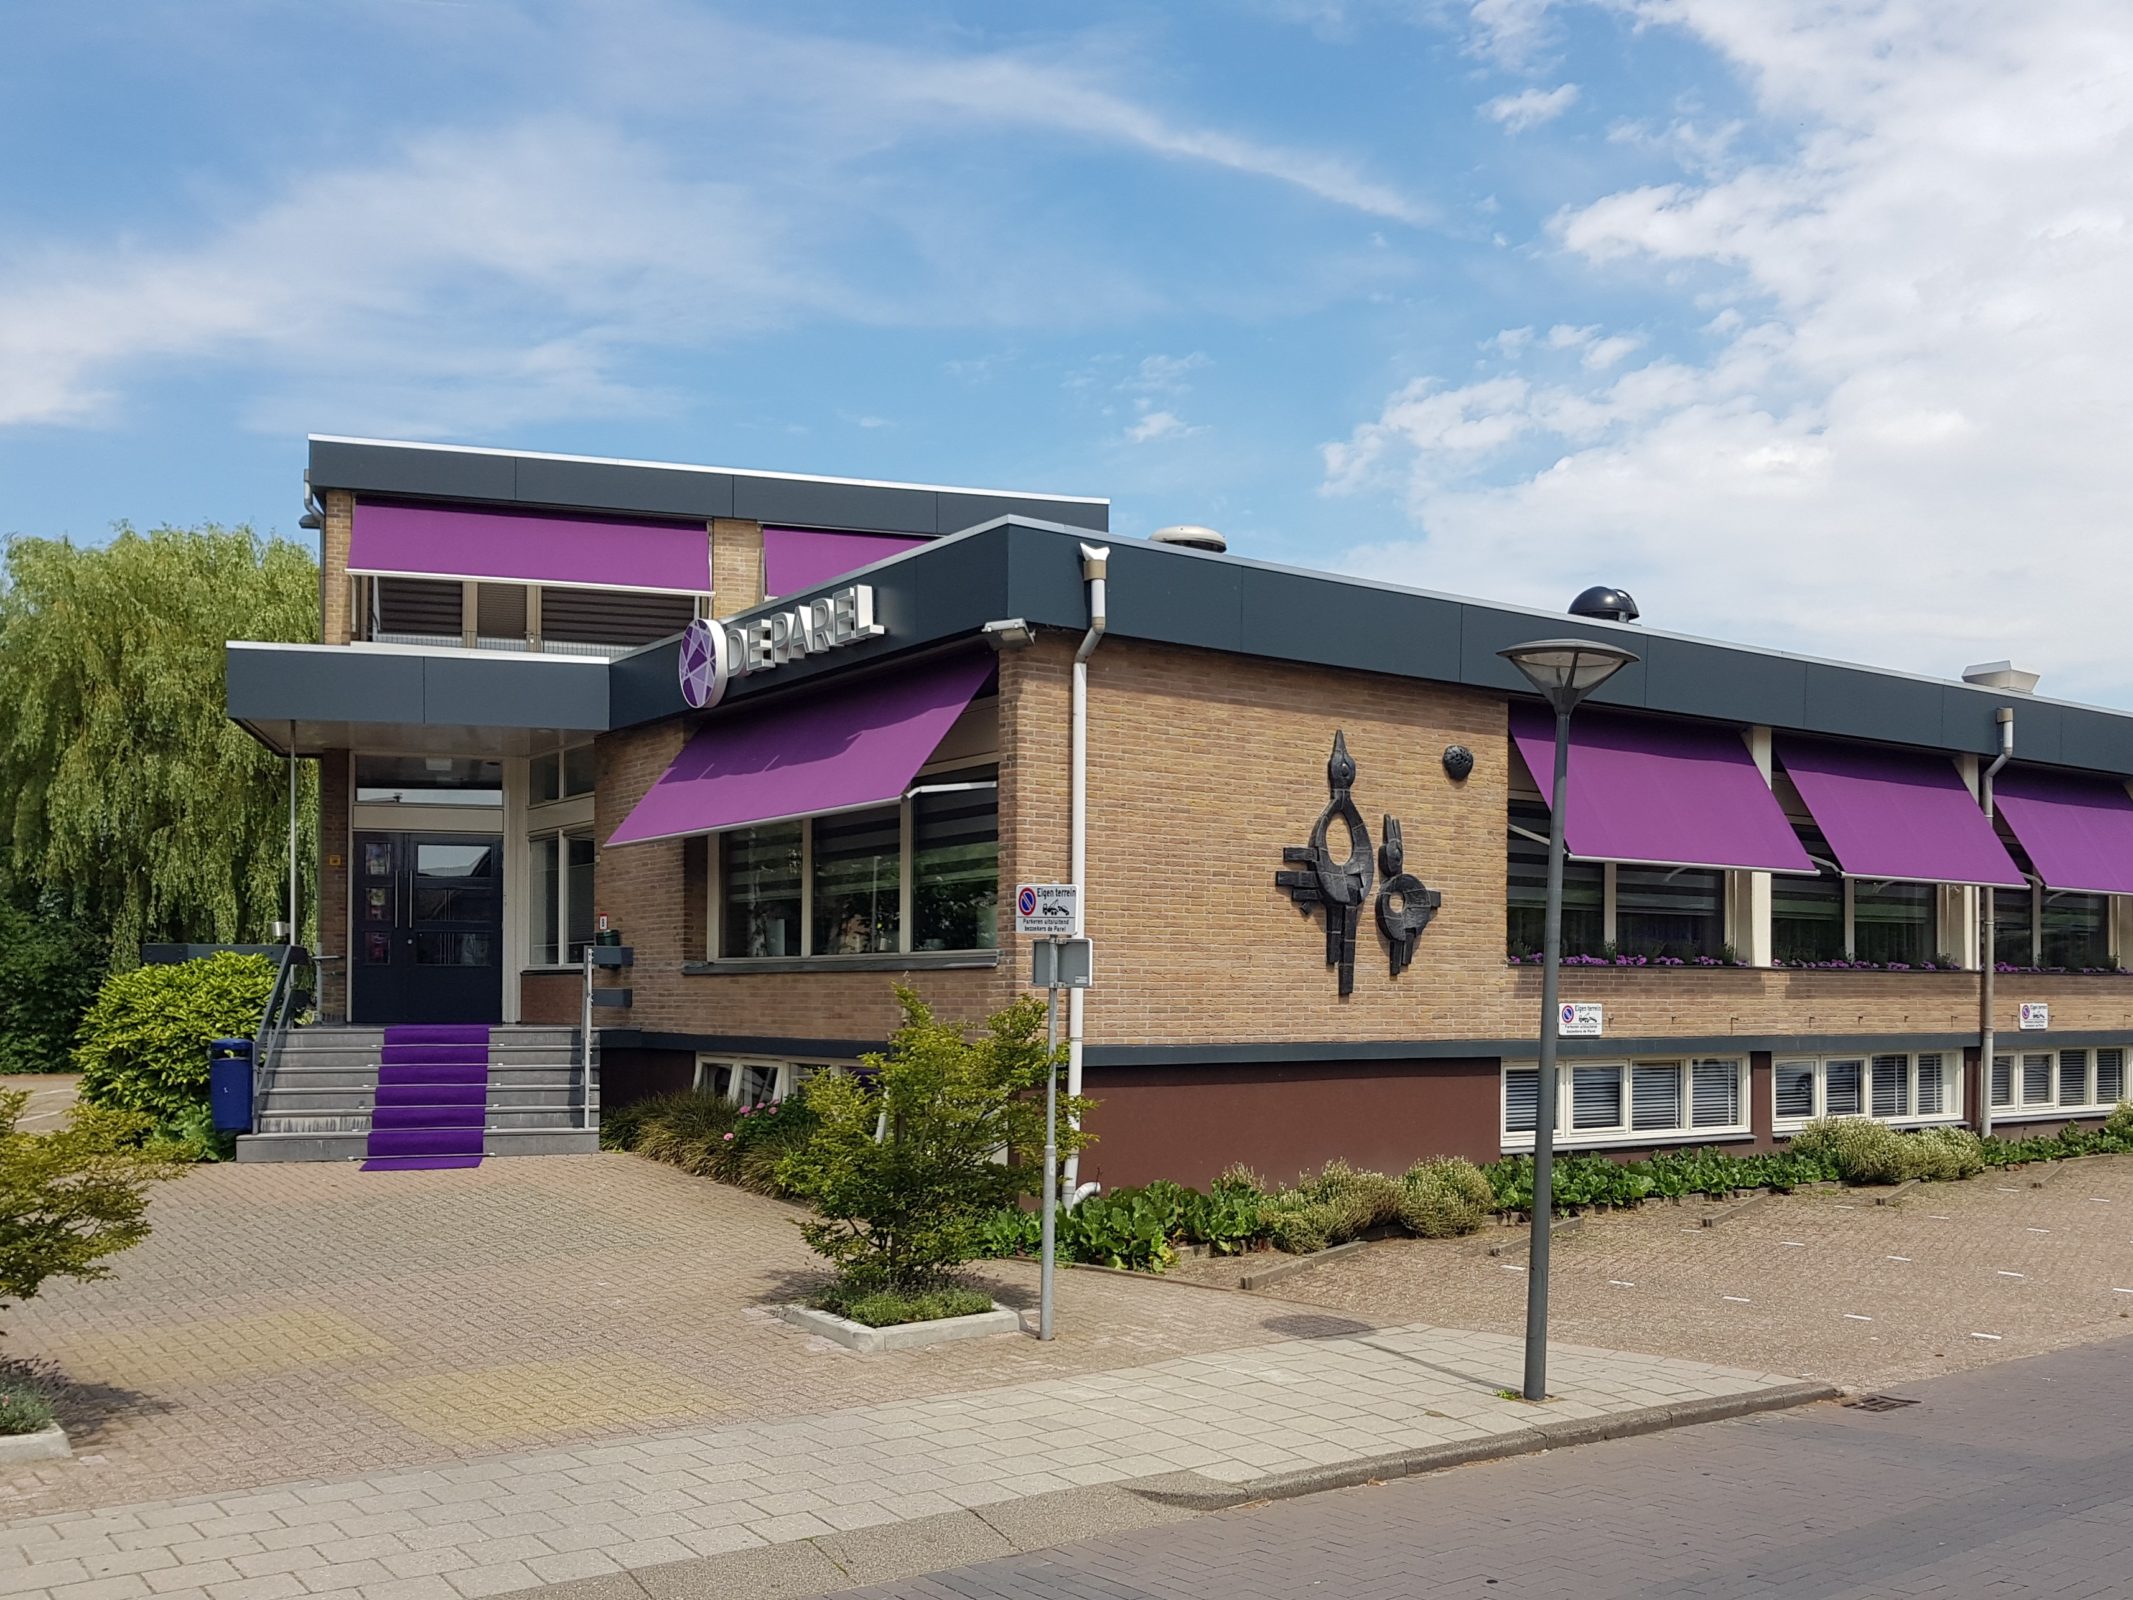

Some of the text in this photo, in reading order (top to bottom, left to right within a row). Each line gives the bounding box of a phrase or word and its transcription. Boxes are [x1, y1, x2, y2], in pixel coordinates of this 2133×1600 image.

[771, 584, 885, 664] PAREL
[1037, 888, 1076, 899] Eigen terrein
